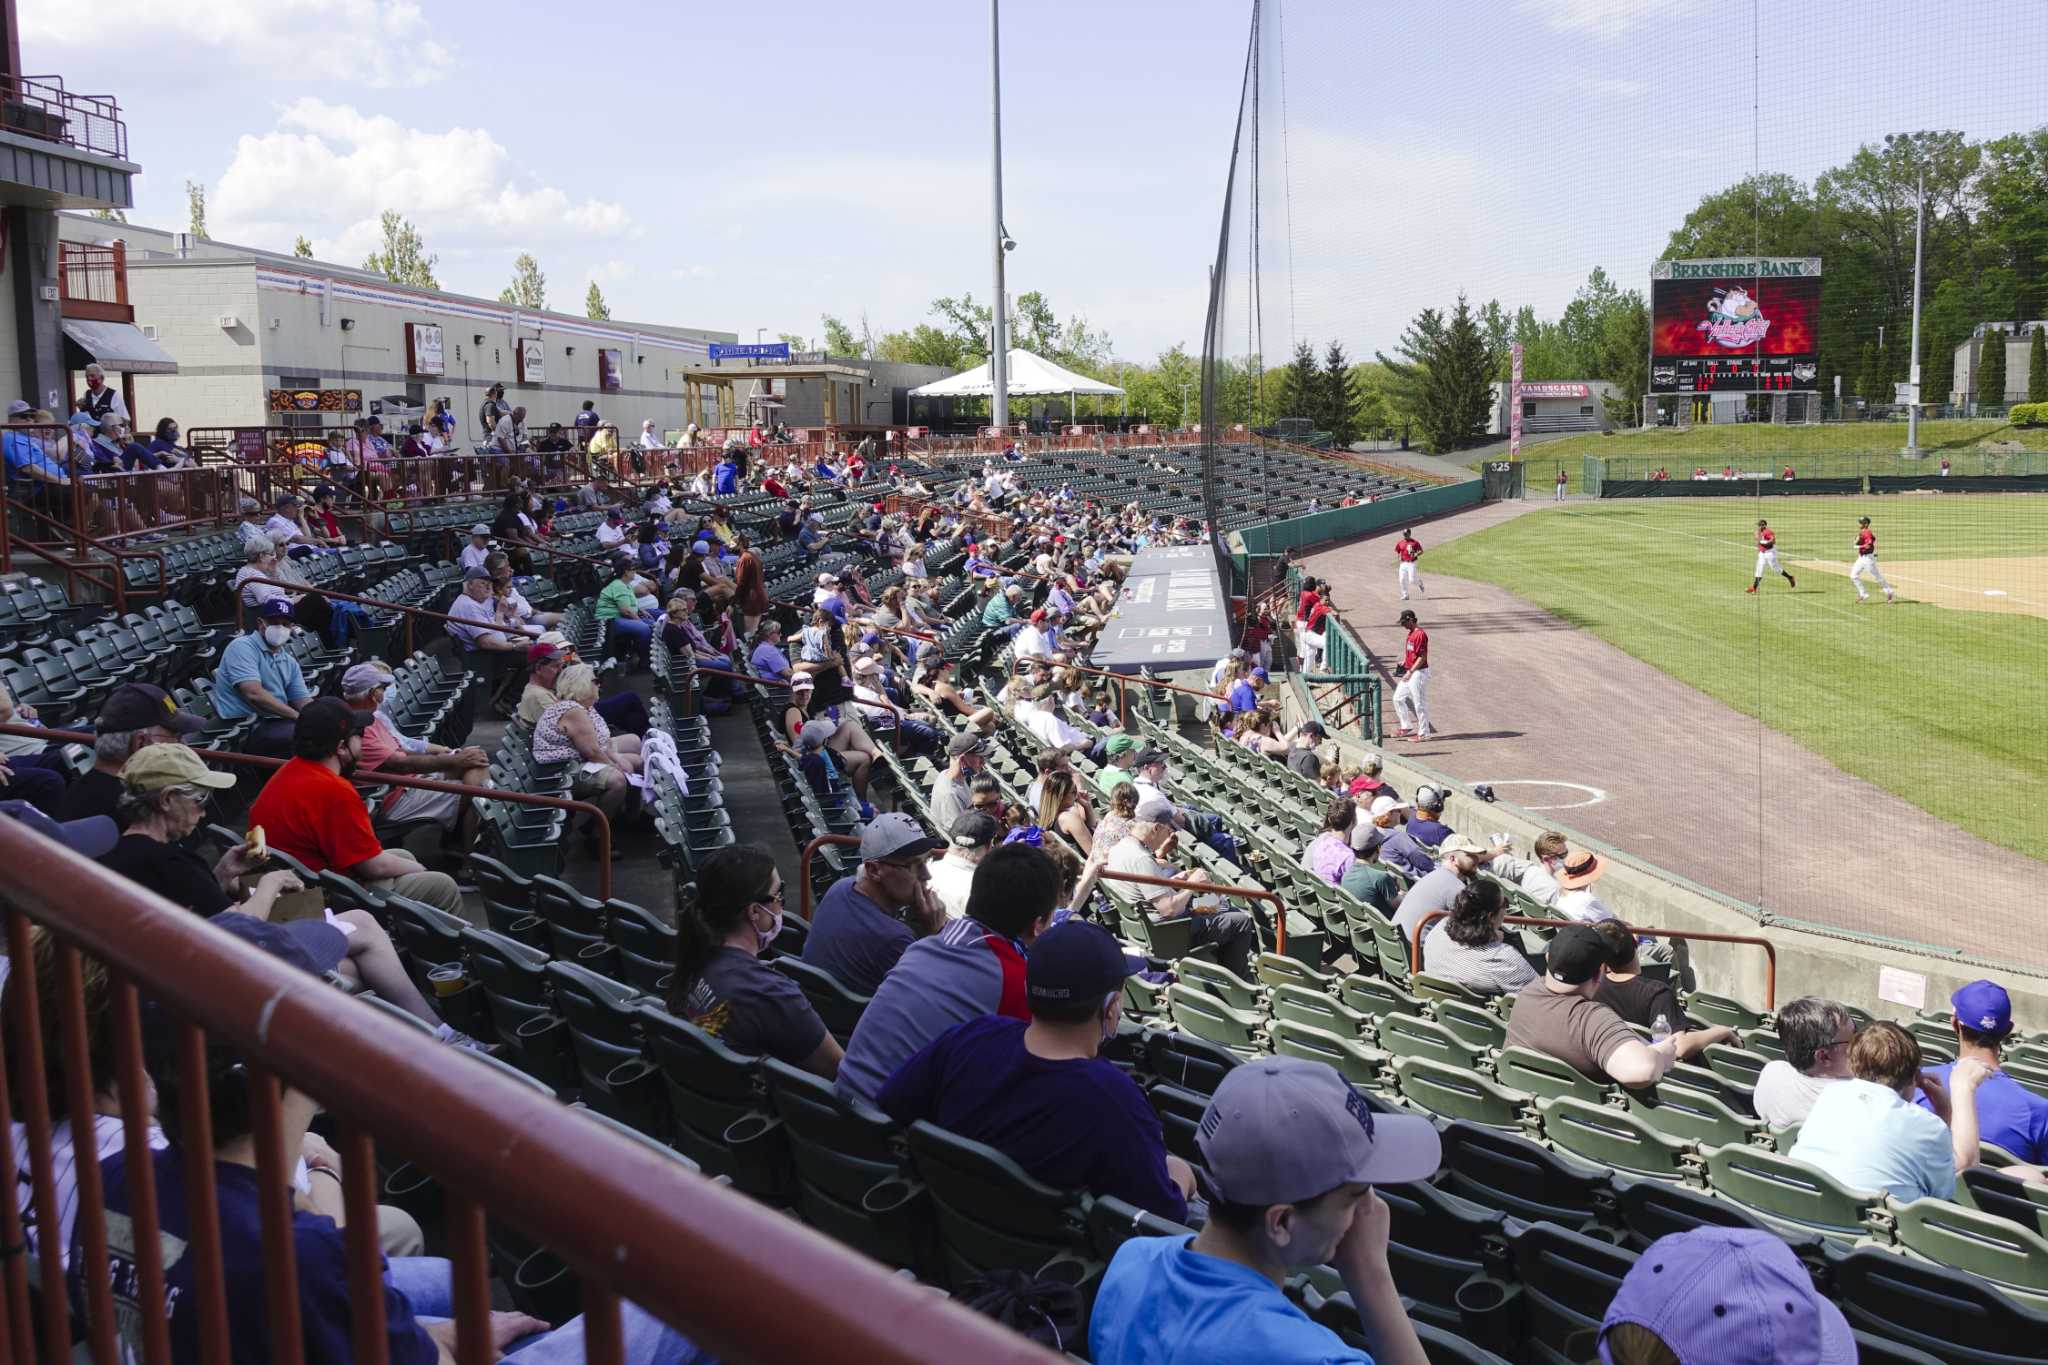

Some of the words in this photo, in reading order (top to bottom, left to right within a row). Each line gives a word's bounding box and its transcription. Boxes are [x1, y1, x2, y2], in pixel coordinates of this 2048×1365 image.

[1671, 262, 1757, 279] BERKSHIRE
[1761, 260, 1803, 276] BANK
[1491, 462, 1510, 472] 325
